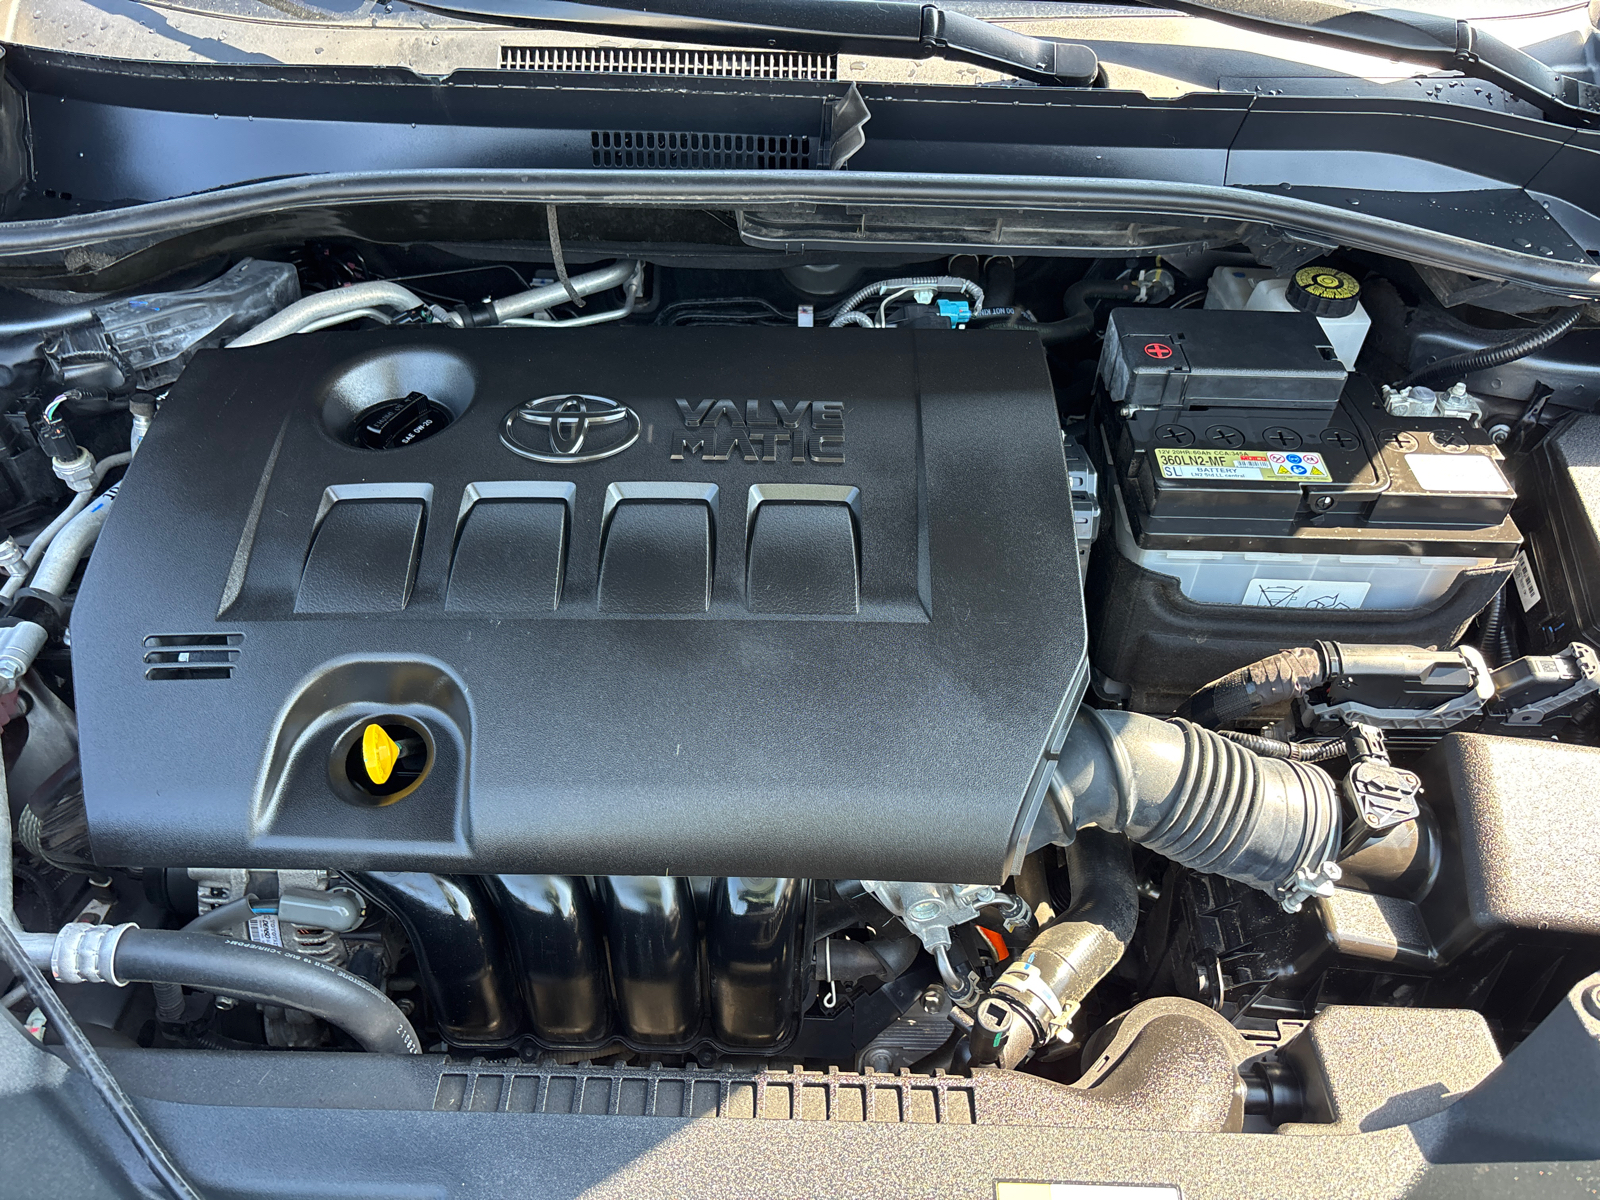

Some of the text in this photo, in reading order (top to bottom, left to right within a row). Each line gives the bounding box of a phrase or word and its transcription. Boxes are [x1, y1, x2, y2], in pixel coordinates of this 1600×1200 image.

[675, 398, 845, 430] VALVE
[401, 419, 433, 444] SAE 0W-20
[670, 428, 845, 463] MATIC
[1160, 455, 1227, 467] 360LN2-MF
[1164, 466, 1182, 477] SL
[262, 919, 271, 938] DENSO
[337, 970, 387, 1003] BRIDGESTONE
